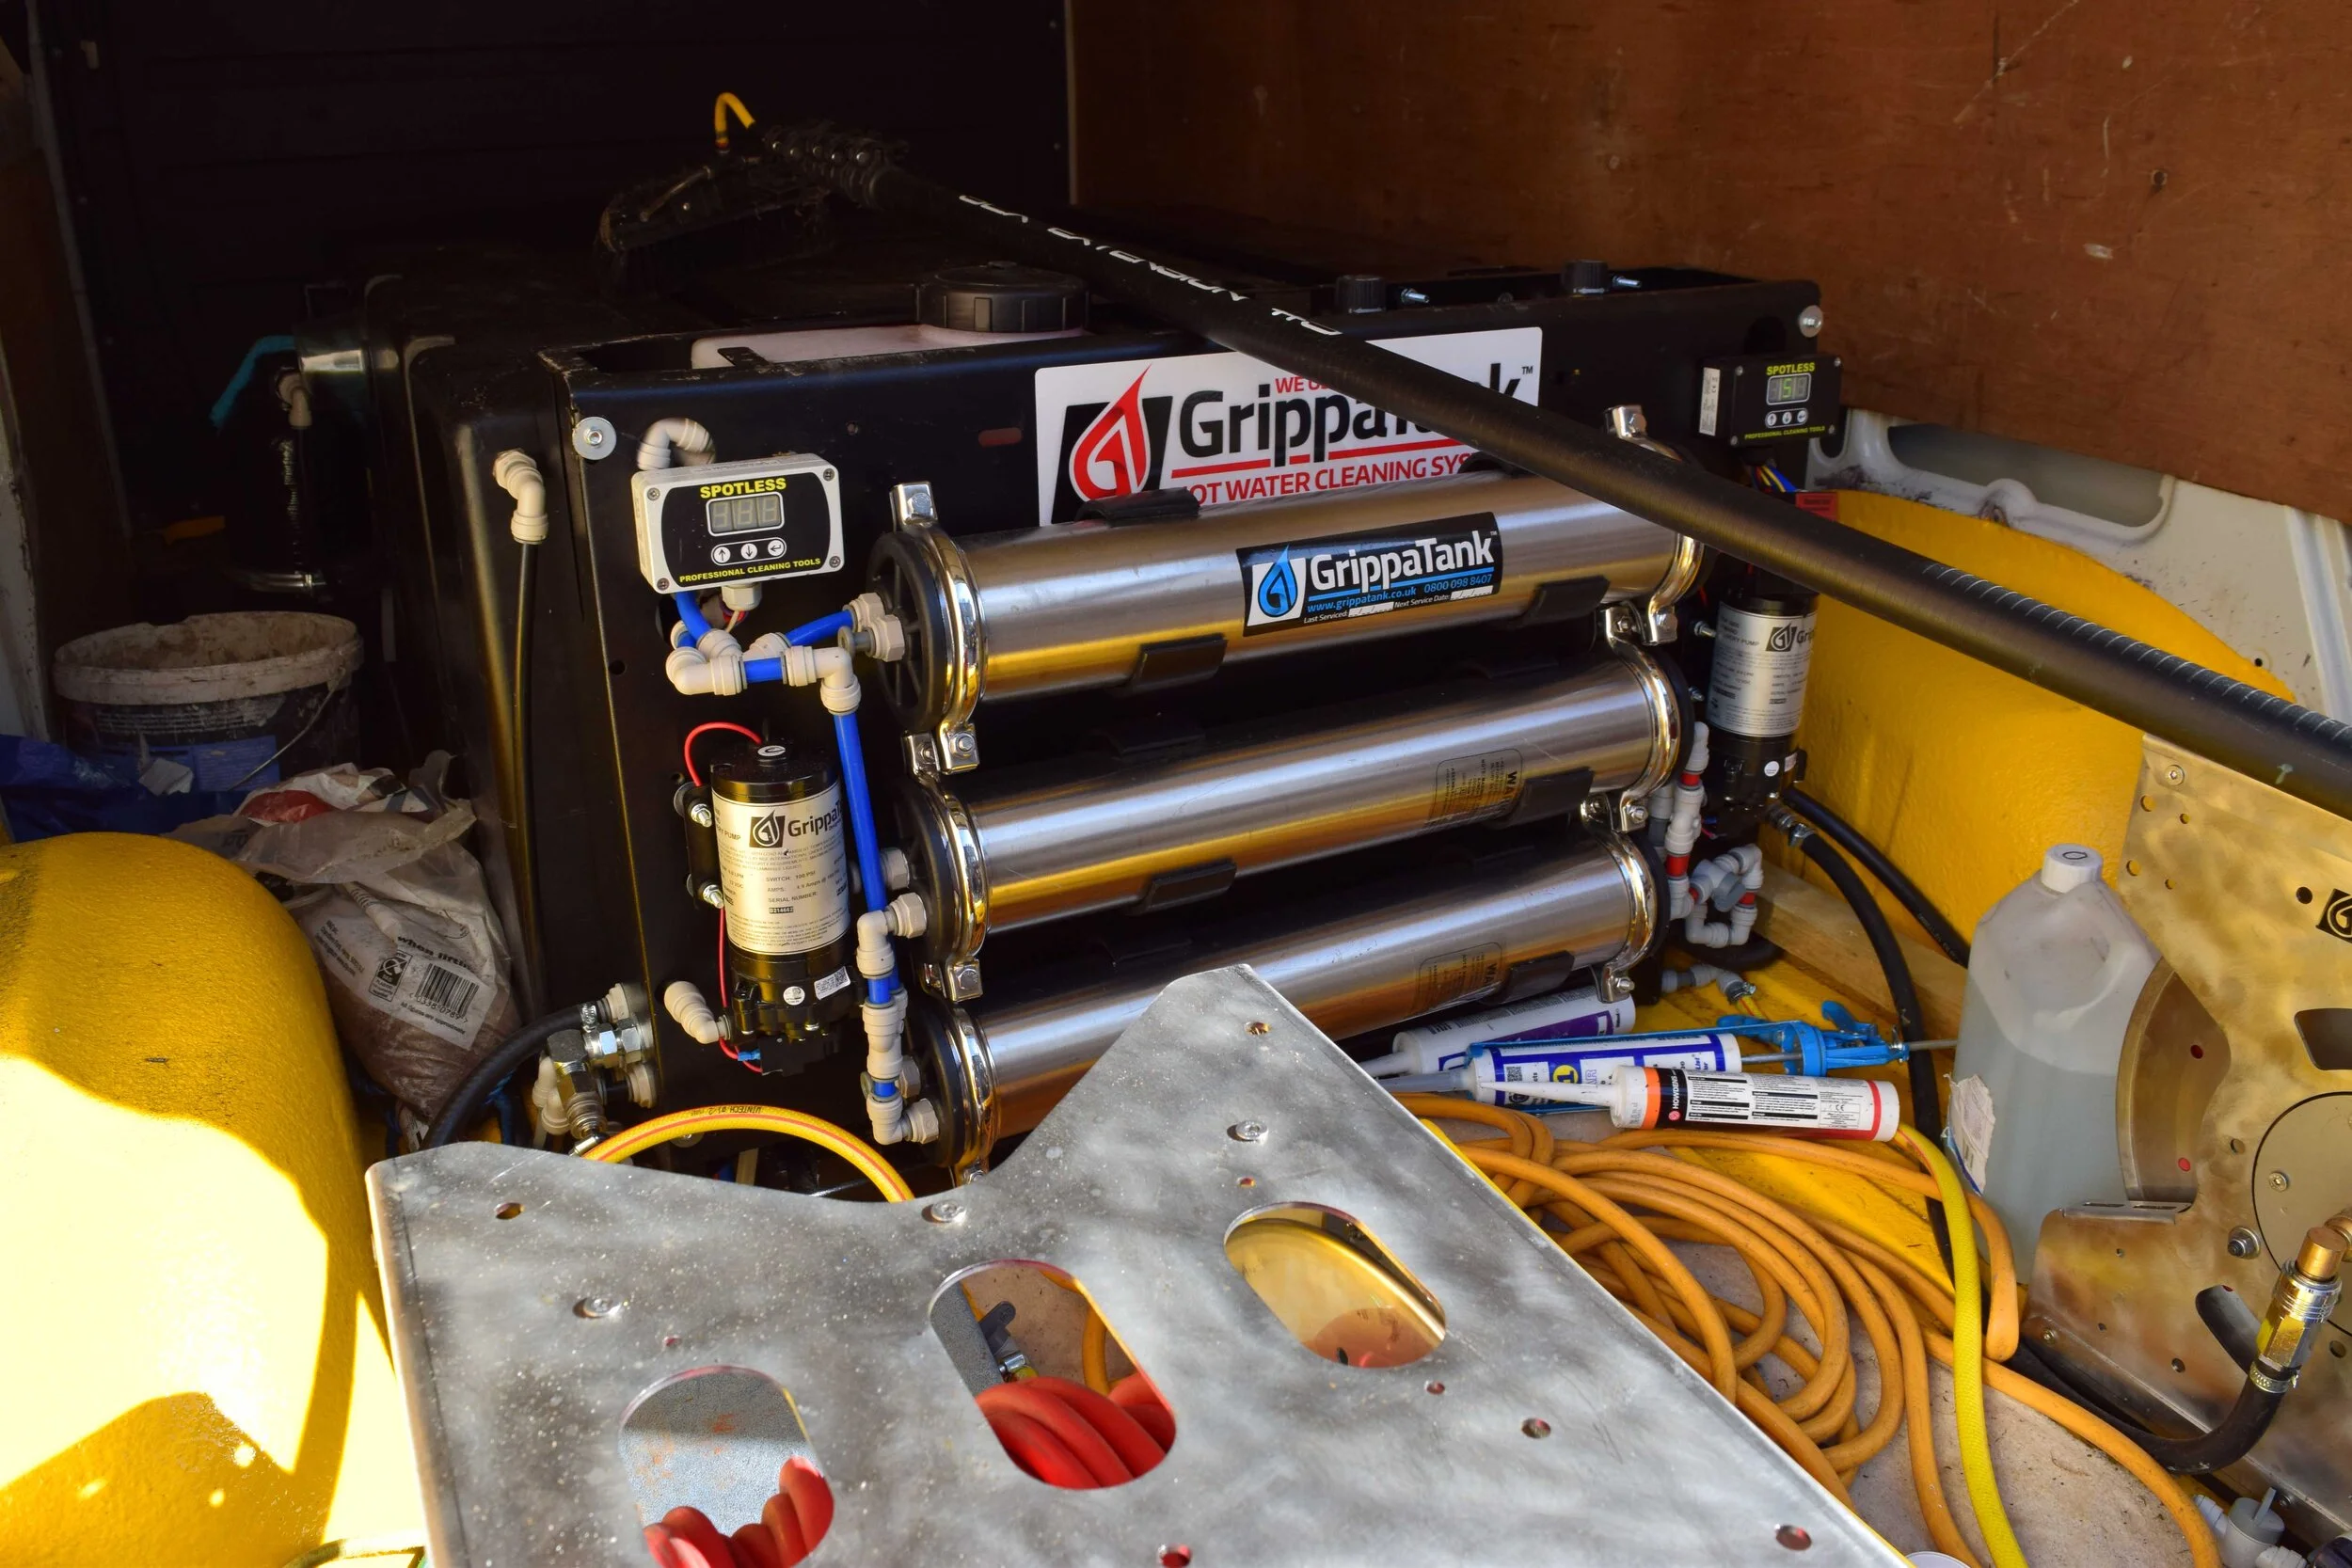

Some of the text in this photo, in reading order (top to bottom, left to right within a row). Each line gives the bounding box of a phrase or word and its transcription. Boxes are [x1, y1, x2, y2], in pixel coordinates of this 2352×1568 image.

[1766, 362, 1816, 376] SPOTLESS
[1275, 375, 1305, 394] WE
[1179, 362, 1521, 467] Grippak
[1783, 427, 1808, 436] CLEANING
[700, 477, 787, 499] SPOTLESS
[1184, 482, 1222, 505] OT
[1225, 472, 1311, 500] WATER
[1314, 458, 1426, 490] CLEANING
[679, 558, 821, 582] PROFESSIONAL CLEANING TOOLS
[1310, 531, 1494, 593] GrippaTank
[1307, 574, 1493, 612] www.grippatank.co.uk 0800 098 8407
[1303, 615, 1319, 624] Last
[1394, 600, 1409, 609] Next
[1410, 596, 1433, 606] Service
